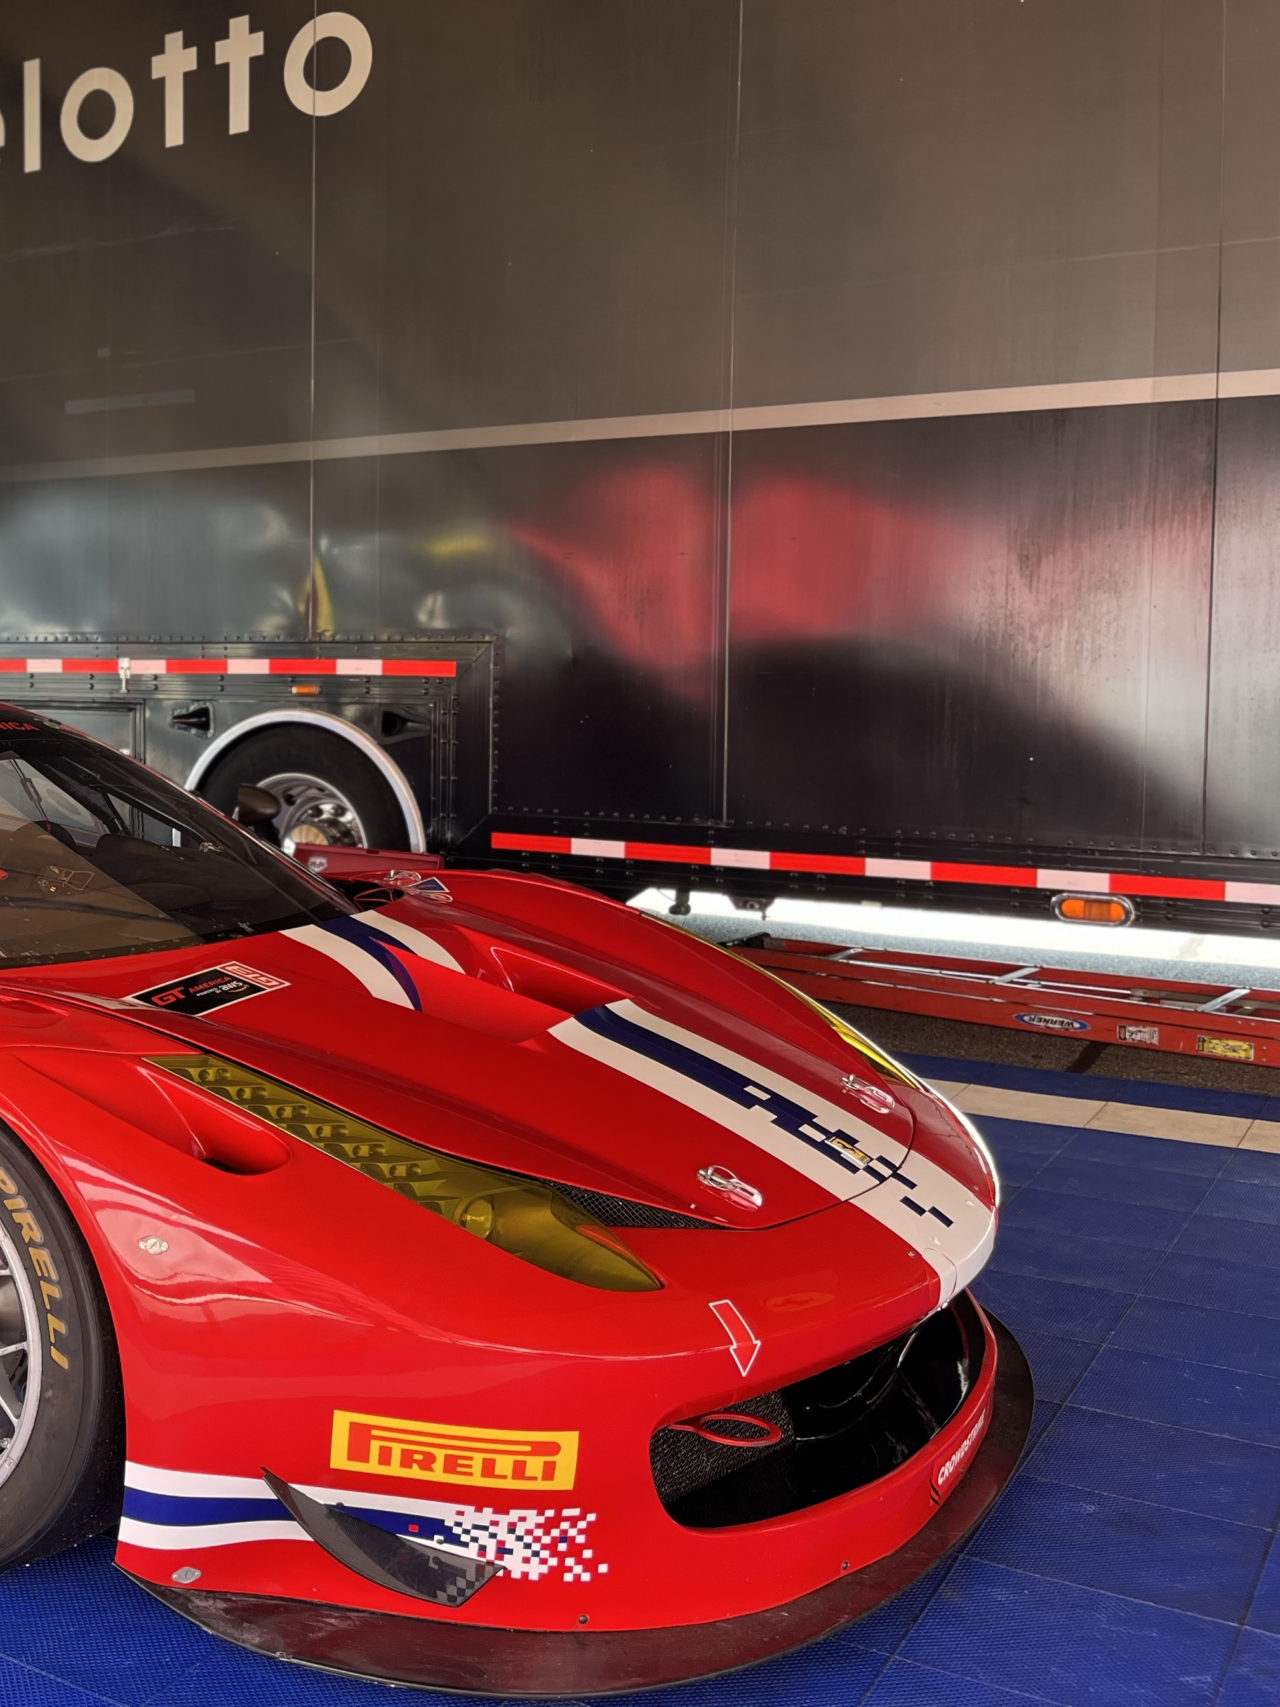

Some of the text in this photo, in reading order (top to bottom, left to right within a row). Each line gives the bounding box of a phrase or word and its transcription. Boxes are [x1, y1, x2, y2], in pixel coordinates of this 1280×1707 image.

[151, 976, 232, 1006] GT AMERICA
[218, 980, 243, 991] aws
[1027, 1015, 1076, 1030] WERNER
[346, 1421, 562, 1482] PIRELLI
